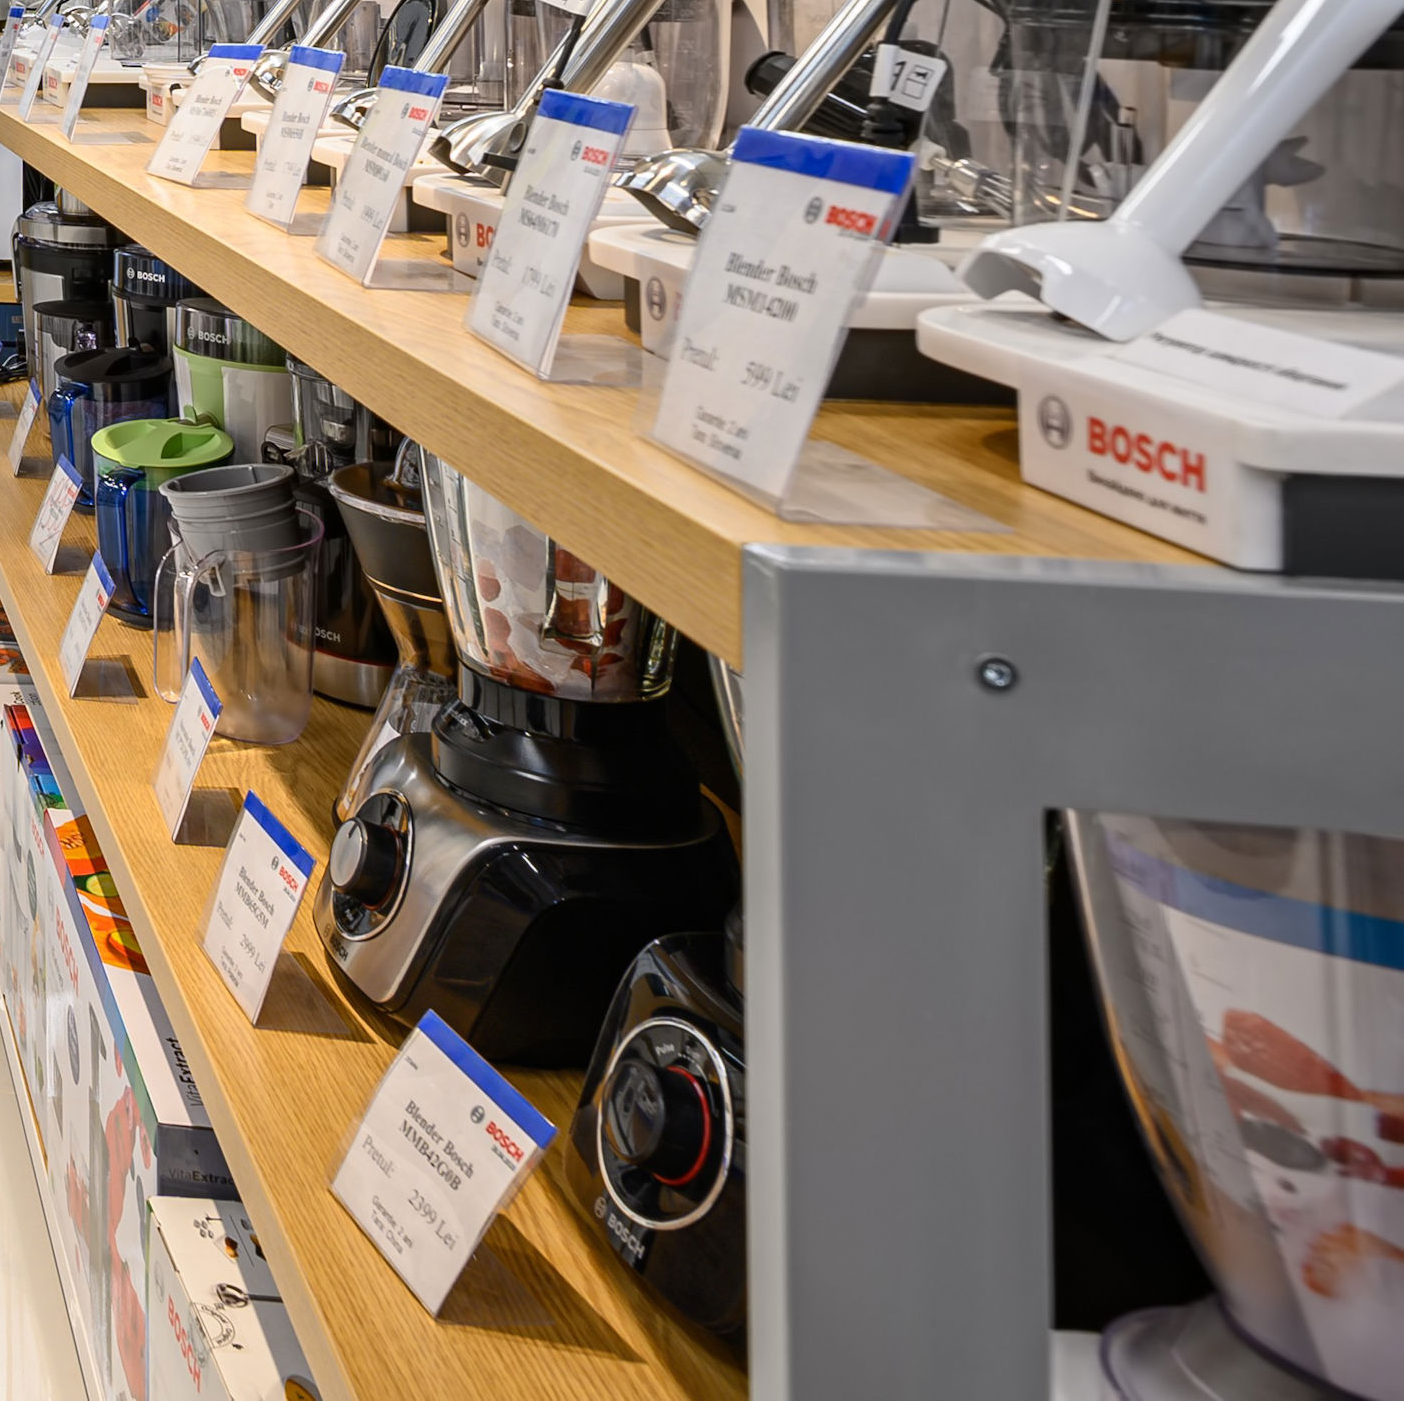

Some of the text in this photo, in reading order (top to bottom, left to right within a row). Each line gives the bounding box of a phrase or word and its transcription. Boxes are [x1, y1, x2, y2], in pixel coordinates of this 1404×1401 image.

[408, 106, 428, 121] BOSCH
[581, 146, 610, 166] BOSCH
[524, 184, 570, 217] Blender Bosch
[825, 204, 878, 234] BOSCH
[136, 269, 166, 284] BOSCH
[725, 252, 818, 295] Blender Bosch
[197, 329, 230, 346] BOSCH
[740, 360, 772, 392] 599
[771, 370, 804, 403] Lei
[1086, 416, 1208, 494] BOSCH
[238, 865, 276, 916] Blender Bosch
[277, 865, 299, 891] BOSCH
[55, 904, 79, 999] BOSCH
[255, 949, 267, 975] Lei
[405, 1099, 445, 1146] Blender
[442, 1139, 476, 1180] Bosch
[485, 1120, 525, 1163] BOSCH
[363, 1134, 460, 1252] Pretul: 2399 Lei
[606, 1212, 646, 1260] BOSCH
[167, 1294, 202, 1395] BOSCH
